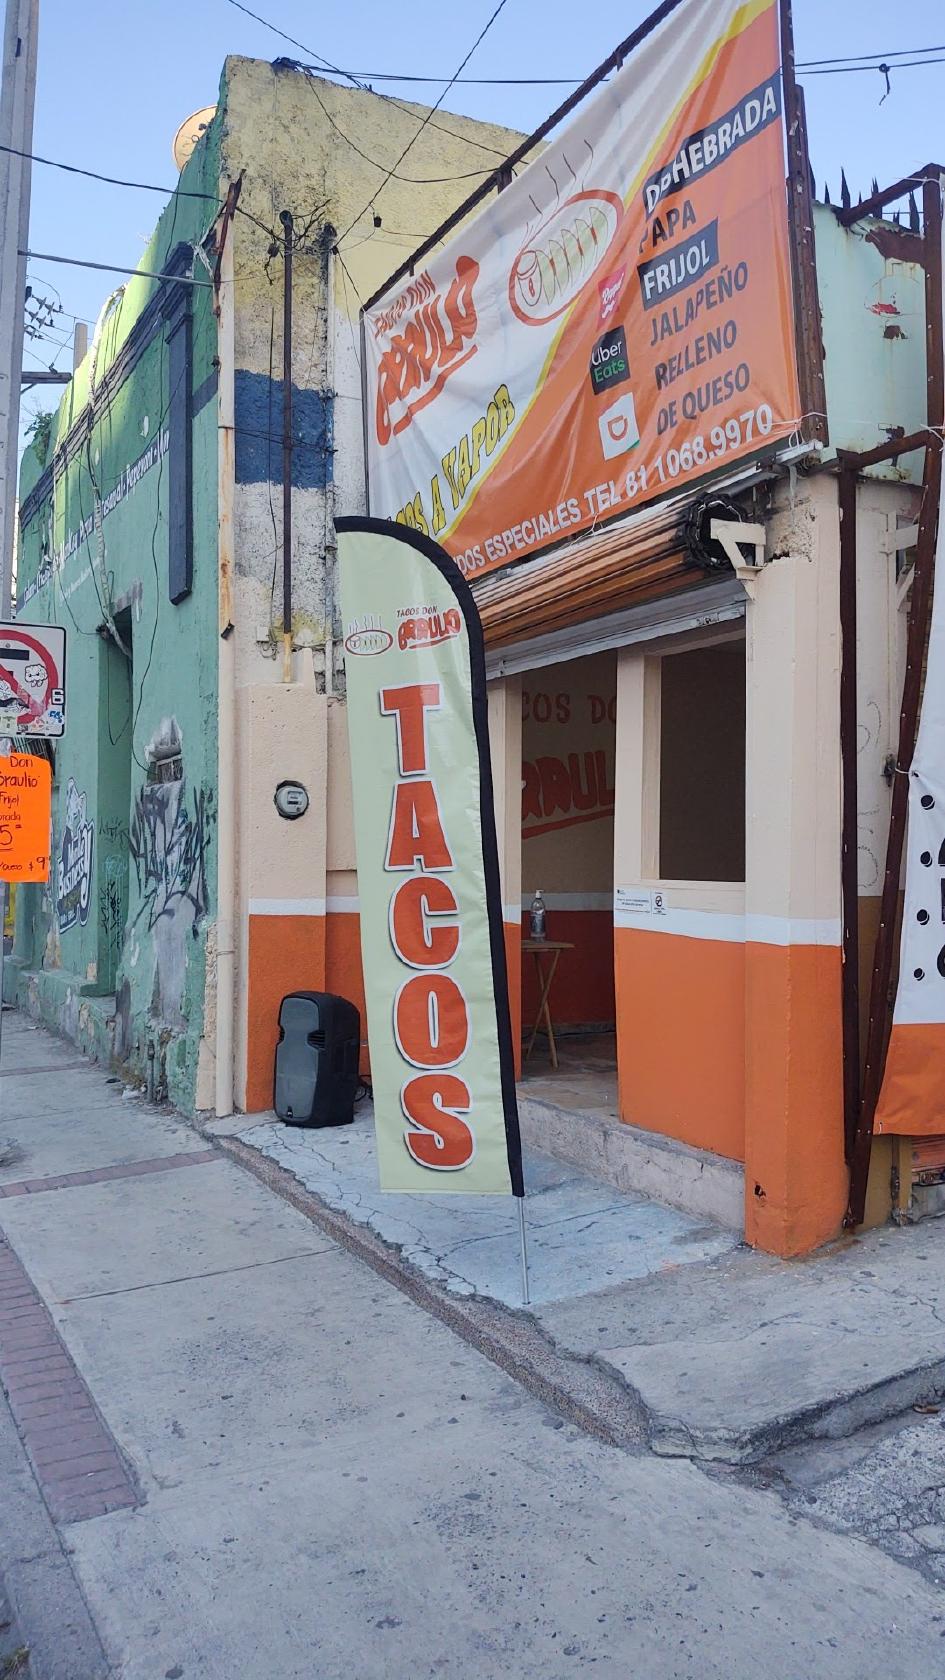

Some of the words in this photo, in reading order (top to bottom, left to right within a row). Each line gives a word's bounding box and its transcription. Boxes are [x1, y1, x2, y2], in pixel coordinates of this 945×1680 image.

[643, 239, 711, 300] FRIJOL
[650, 261, 749, 346] JALAPEÑO
[592, 340, 623, 366] Uber
[593, 358, 626, 383] Eats
[655, 319, 737, 391] RELLENO
[657, 399, 678, 436] DE
[682, 362, 750, 420] QUESO
[431, 474, 446, 533] A
[442, 383, 515, 510] VAPOR
[453, 545, 486, 574] DOS
[485, 498, 582, 562] ESPECIALES
[625, 464, 648, 498] 81
[653, 404, 773, 482] 1068.9970
[396, 608, 419, 618] TACOS
[420, 605, 438, 616] DON
[10, 755, 33, 768] Don
[380, 681, 477, 1171] TACOS
